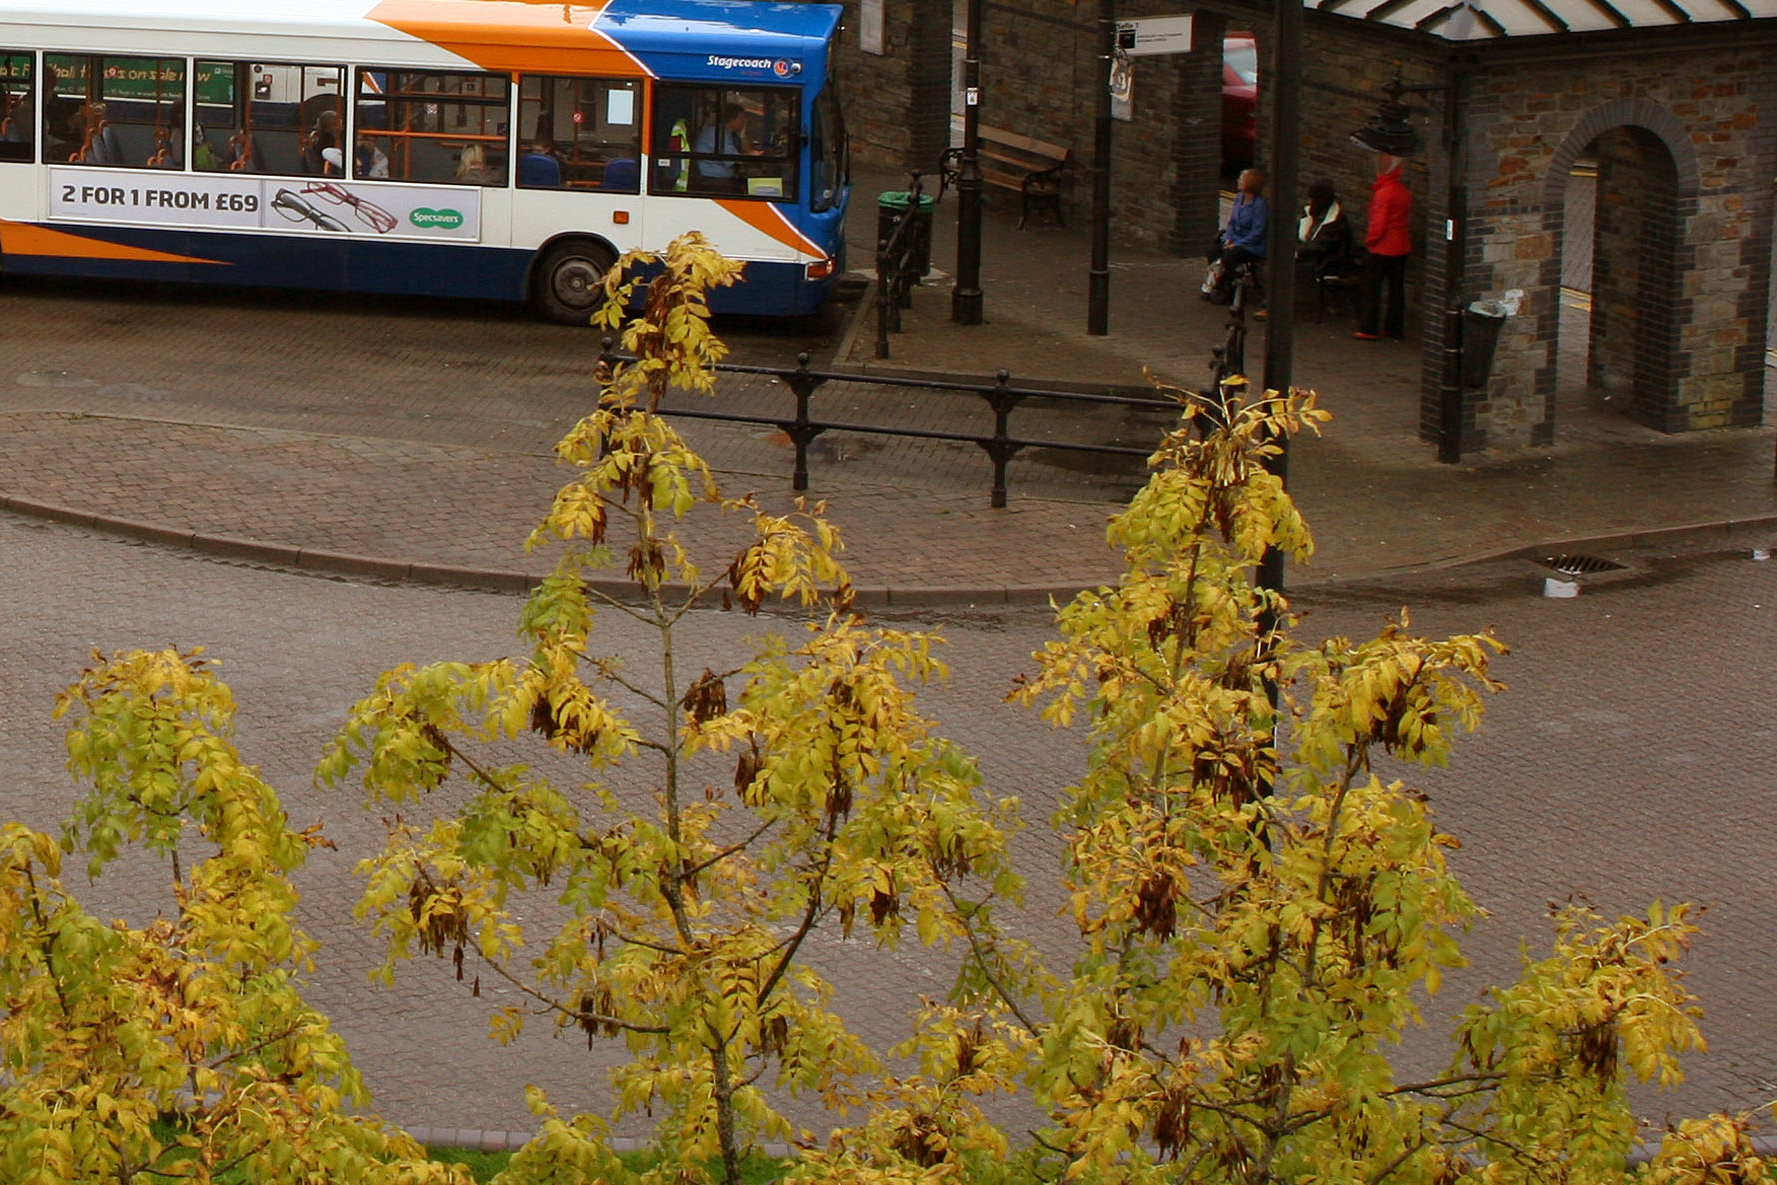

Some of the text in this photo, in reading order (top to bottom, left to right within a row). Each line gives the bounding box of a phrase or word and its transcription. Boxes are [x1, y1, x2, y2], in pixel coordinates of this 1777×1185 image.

[707, 55, 772, 70] Stagecoach
[62, 185, 259, 212] 2 FOR 1 FROM £69
[414, 212, 459, 223] Specsavers
